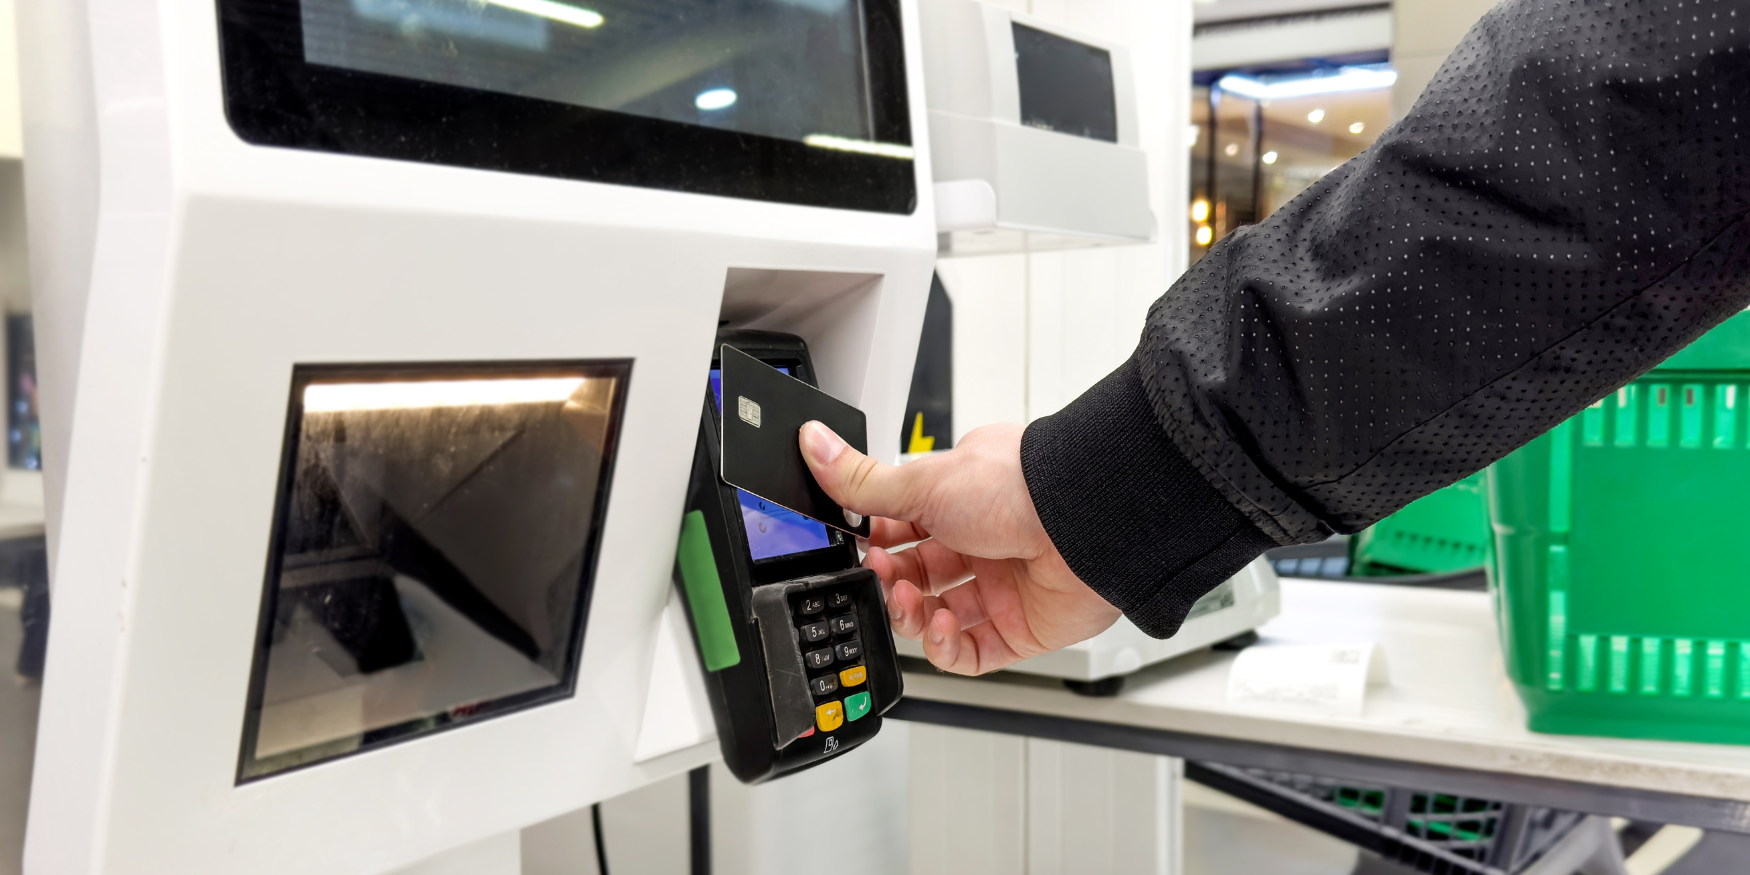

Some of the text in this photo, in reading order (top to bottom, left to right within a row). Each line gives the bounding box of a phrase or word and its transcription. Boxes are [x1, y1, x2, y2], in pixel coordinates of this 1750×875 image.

[835, 592, 840, 604] 3
[806, 599, 812, 611] 2
[839, 619, 844, 630] 6
[811, 626, 817, 637] 5
[843, 646, 849, 657] 9
[815, 653, 820, 664] 8
[819, 680, 825, 691] 0
